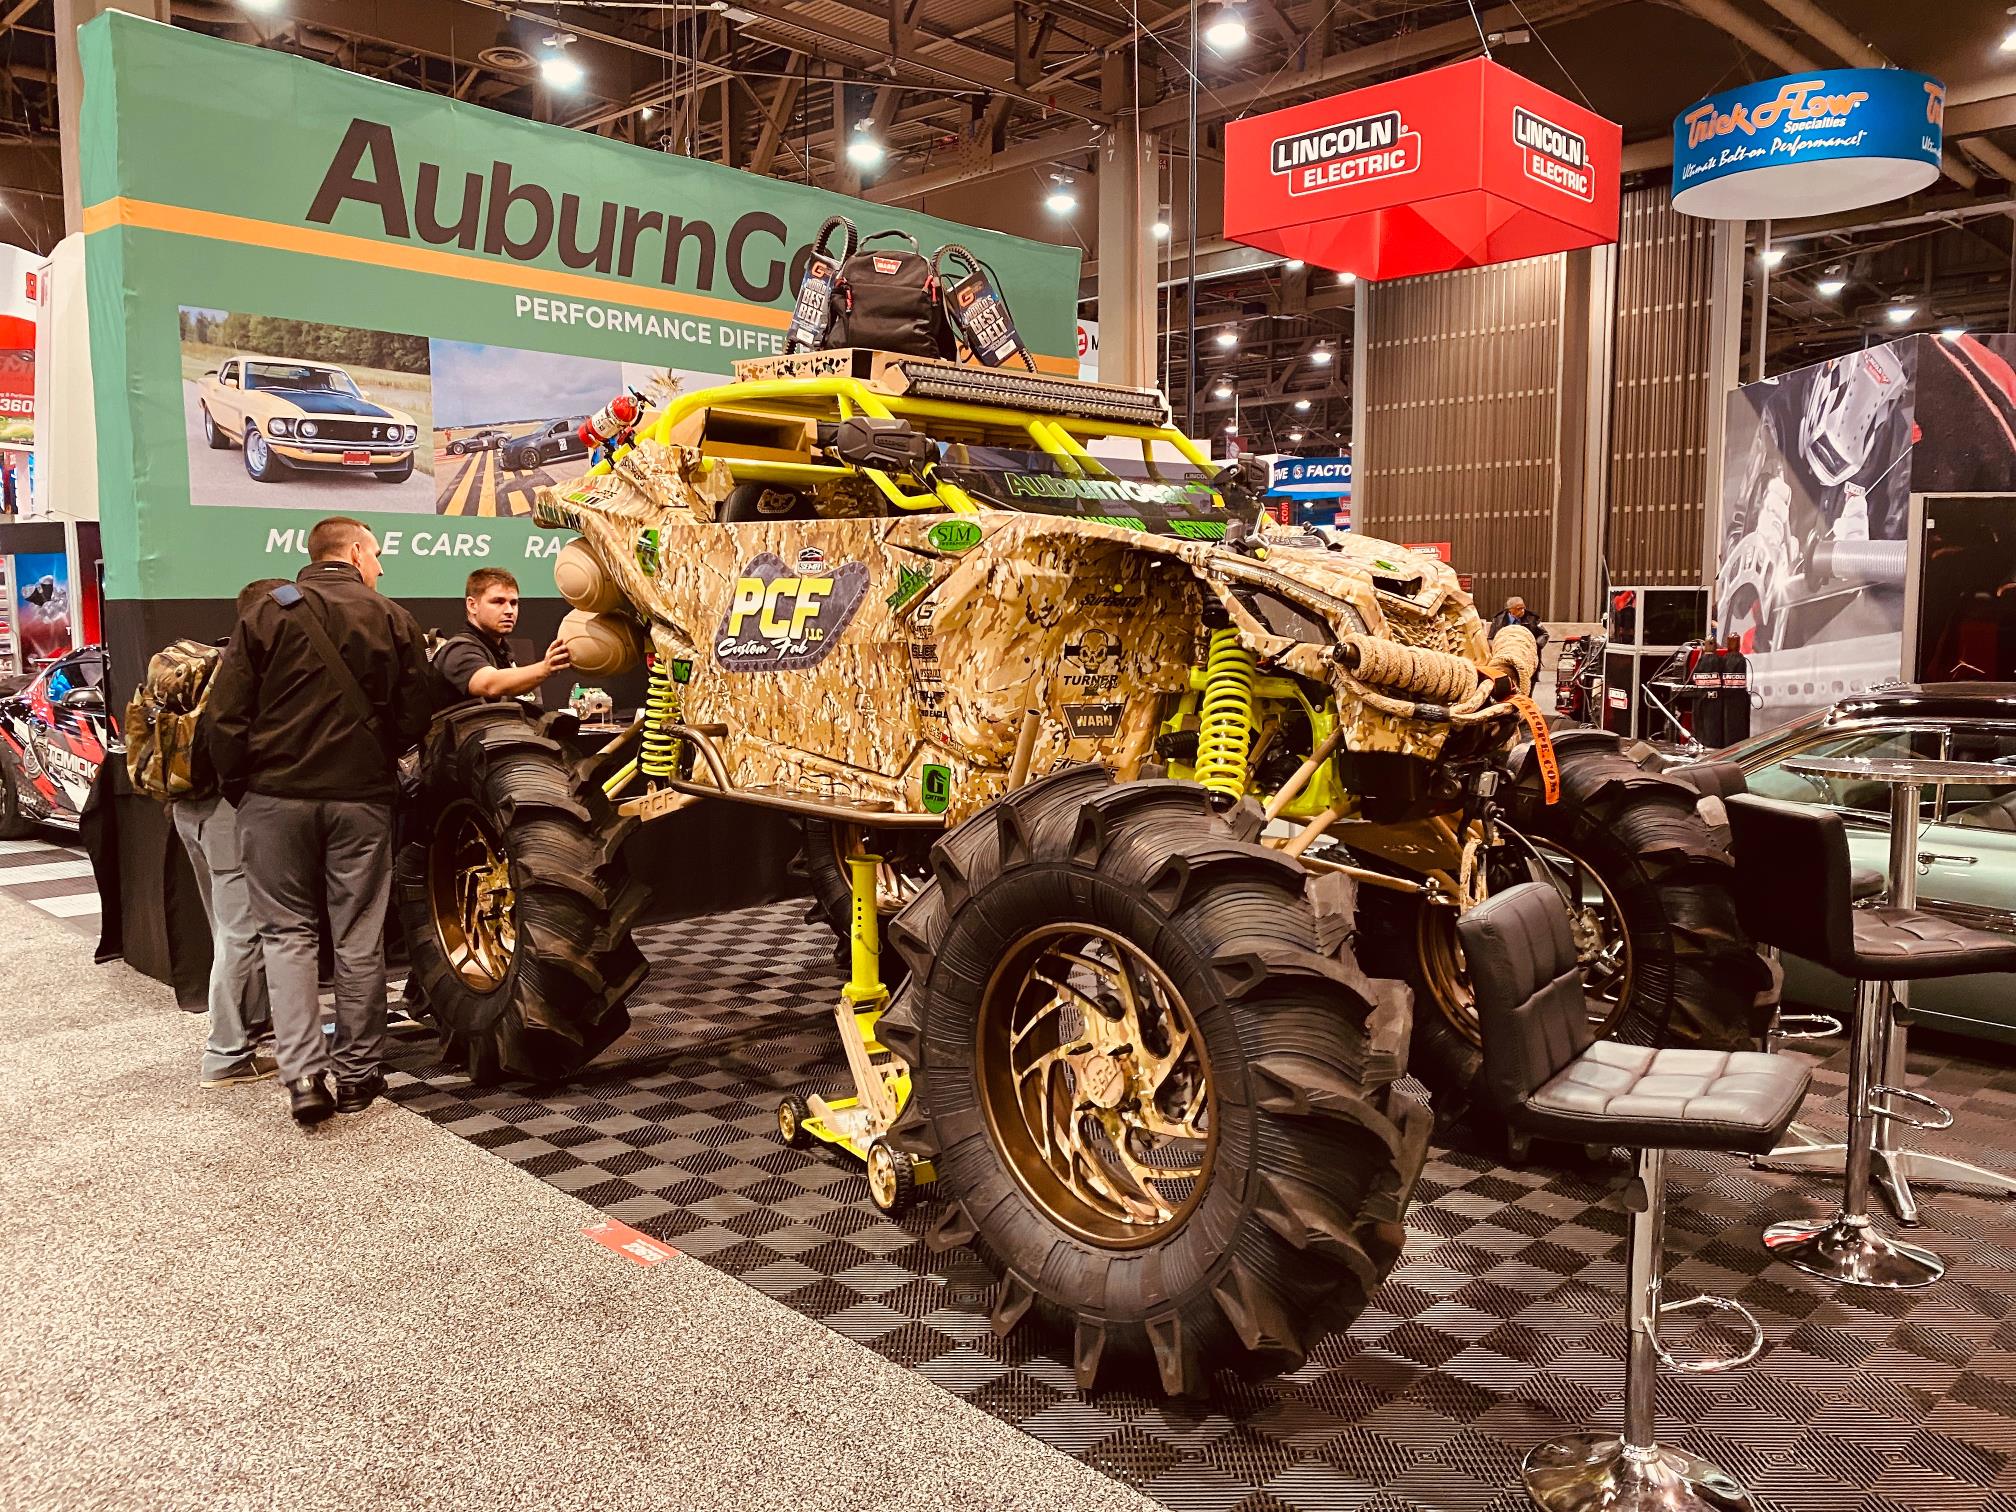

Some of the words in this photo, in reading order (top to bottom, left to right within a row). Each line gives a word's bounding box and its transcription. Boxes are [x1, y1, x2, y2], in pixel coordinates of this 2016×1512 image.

[1684, 102, 1757, 150] Trick
[1751, 79, 1870, 129] Flow
[1783, 116, 1847, 134] Specialties
[1277, 117, 1393, 169] LINCOLN
[1516, 113, 1582, 166] LINCOLN
[1303, 149, 1406, 189] ELECTRIC
[1532, 154, 1588, 194] ELECTRIC
[1682, 155, 1717, 181] Ultimate
[1718, 147, 1767, 168] Bolt-on
[514, 294, 713, 346] PERFORMANCE
[719, 326, 787, 355] DIFFE
[969, 303, 1002, 333] BEST
[976, 316, 1009, 348] BELT
[411, 532, 492, 558] CARS
[727, 577, 834, 640] PCF
[717, 637, 769, 659] Custom
[770, 636, 809, 661] Fab
[1063, 674, 1119, 686] TURNER
[1076, 714, 1113, 727] WARN
